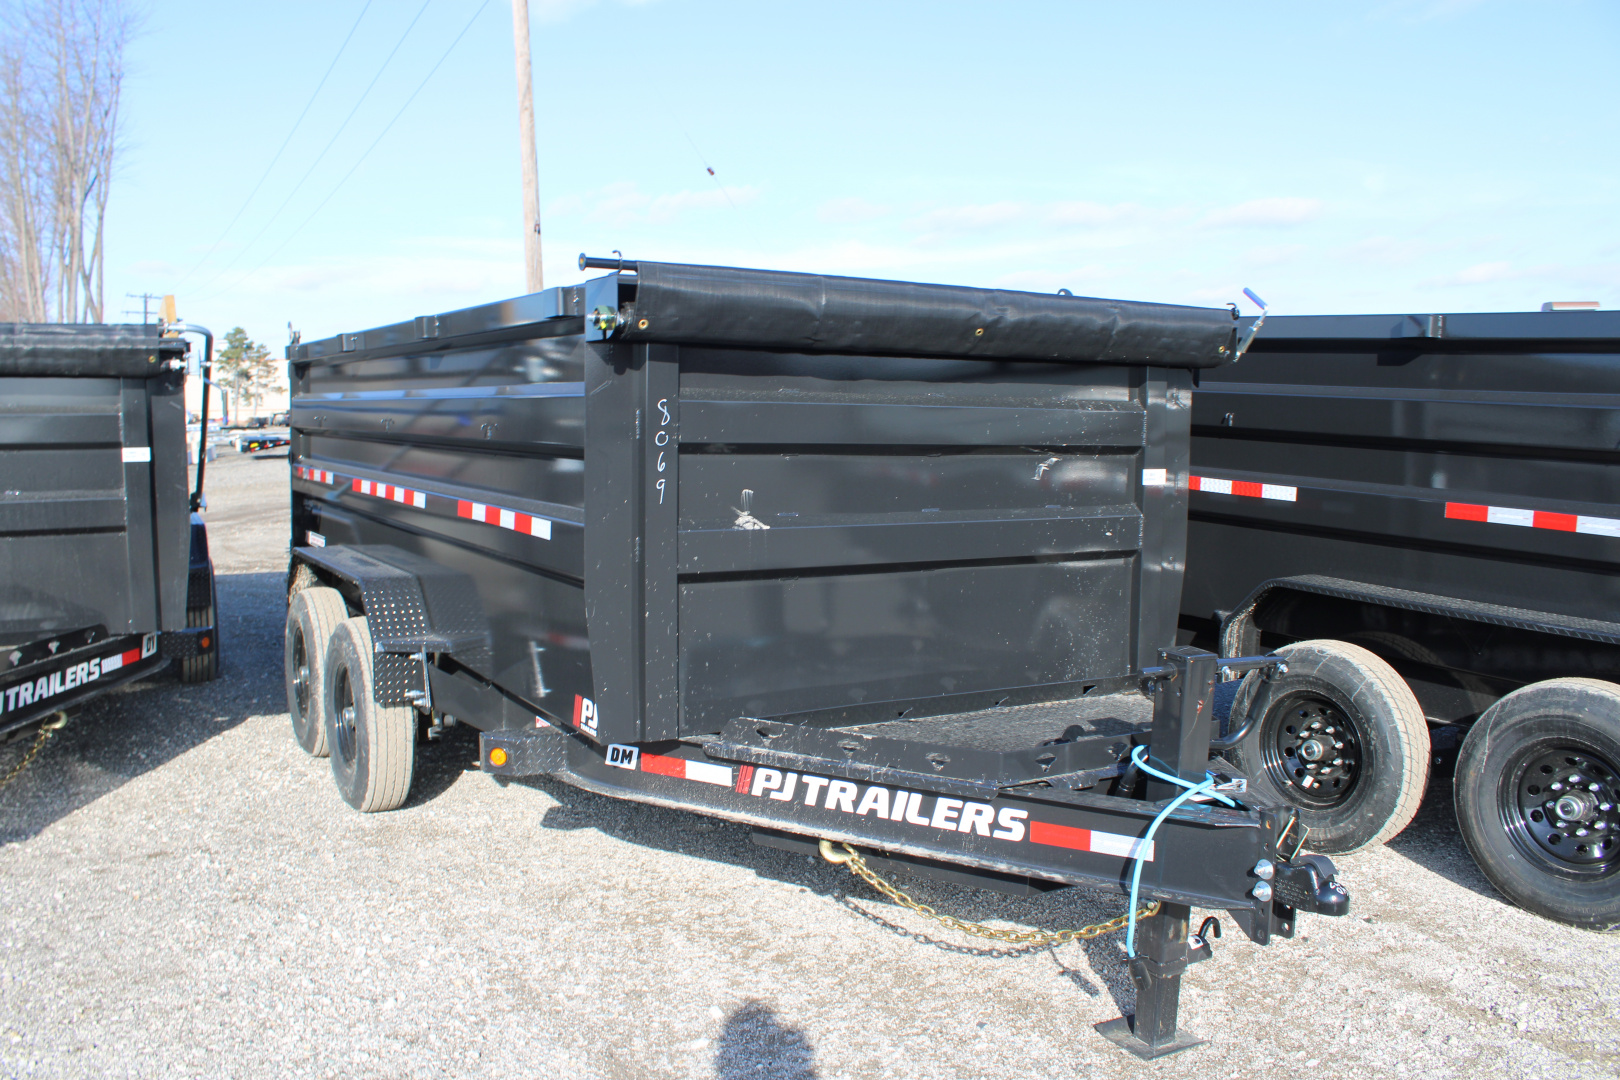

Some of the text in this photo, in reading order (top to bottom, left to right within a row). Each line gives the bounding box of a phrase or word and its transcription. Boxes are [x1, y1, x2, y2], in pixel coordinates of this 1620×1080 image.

[655, 399, 670, 504] 8069
[6, 657, 100, 712] TRAILERS
[610, 746, 634, 764] DM
[751, 767, 1028, 842] PJ TRAILERS
